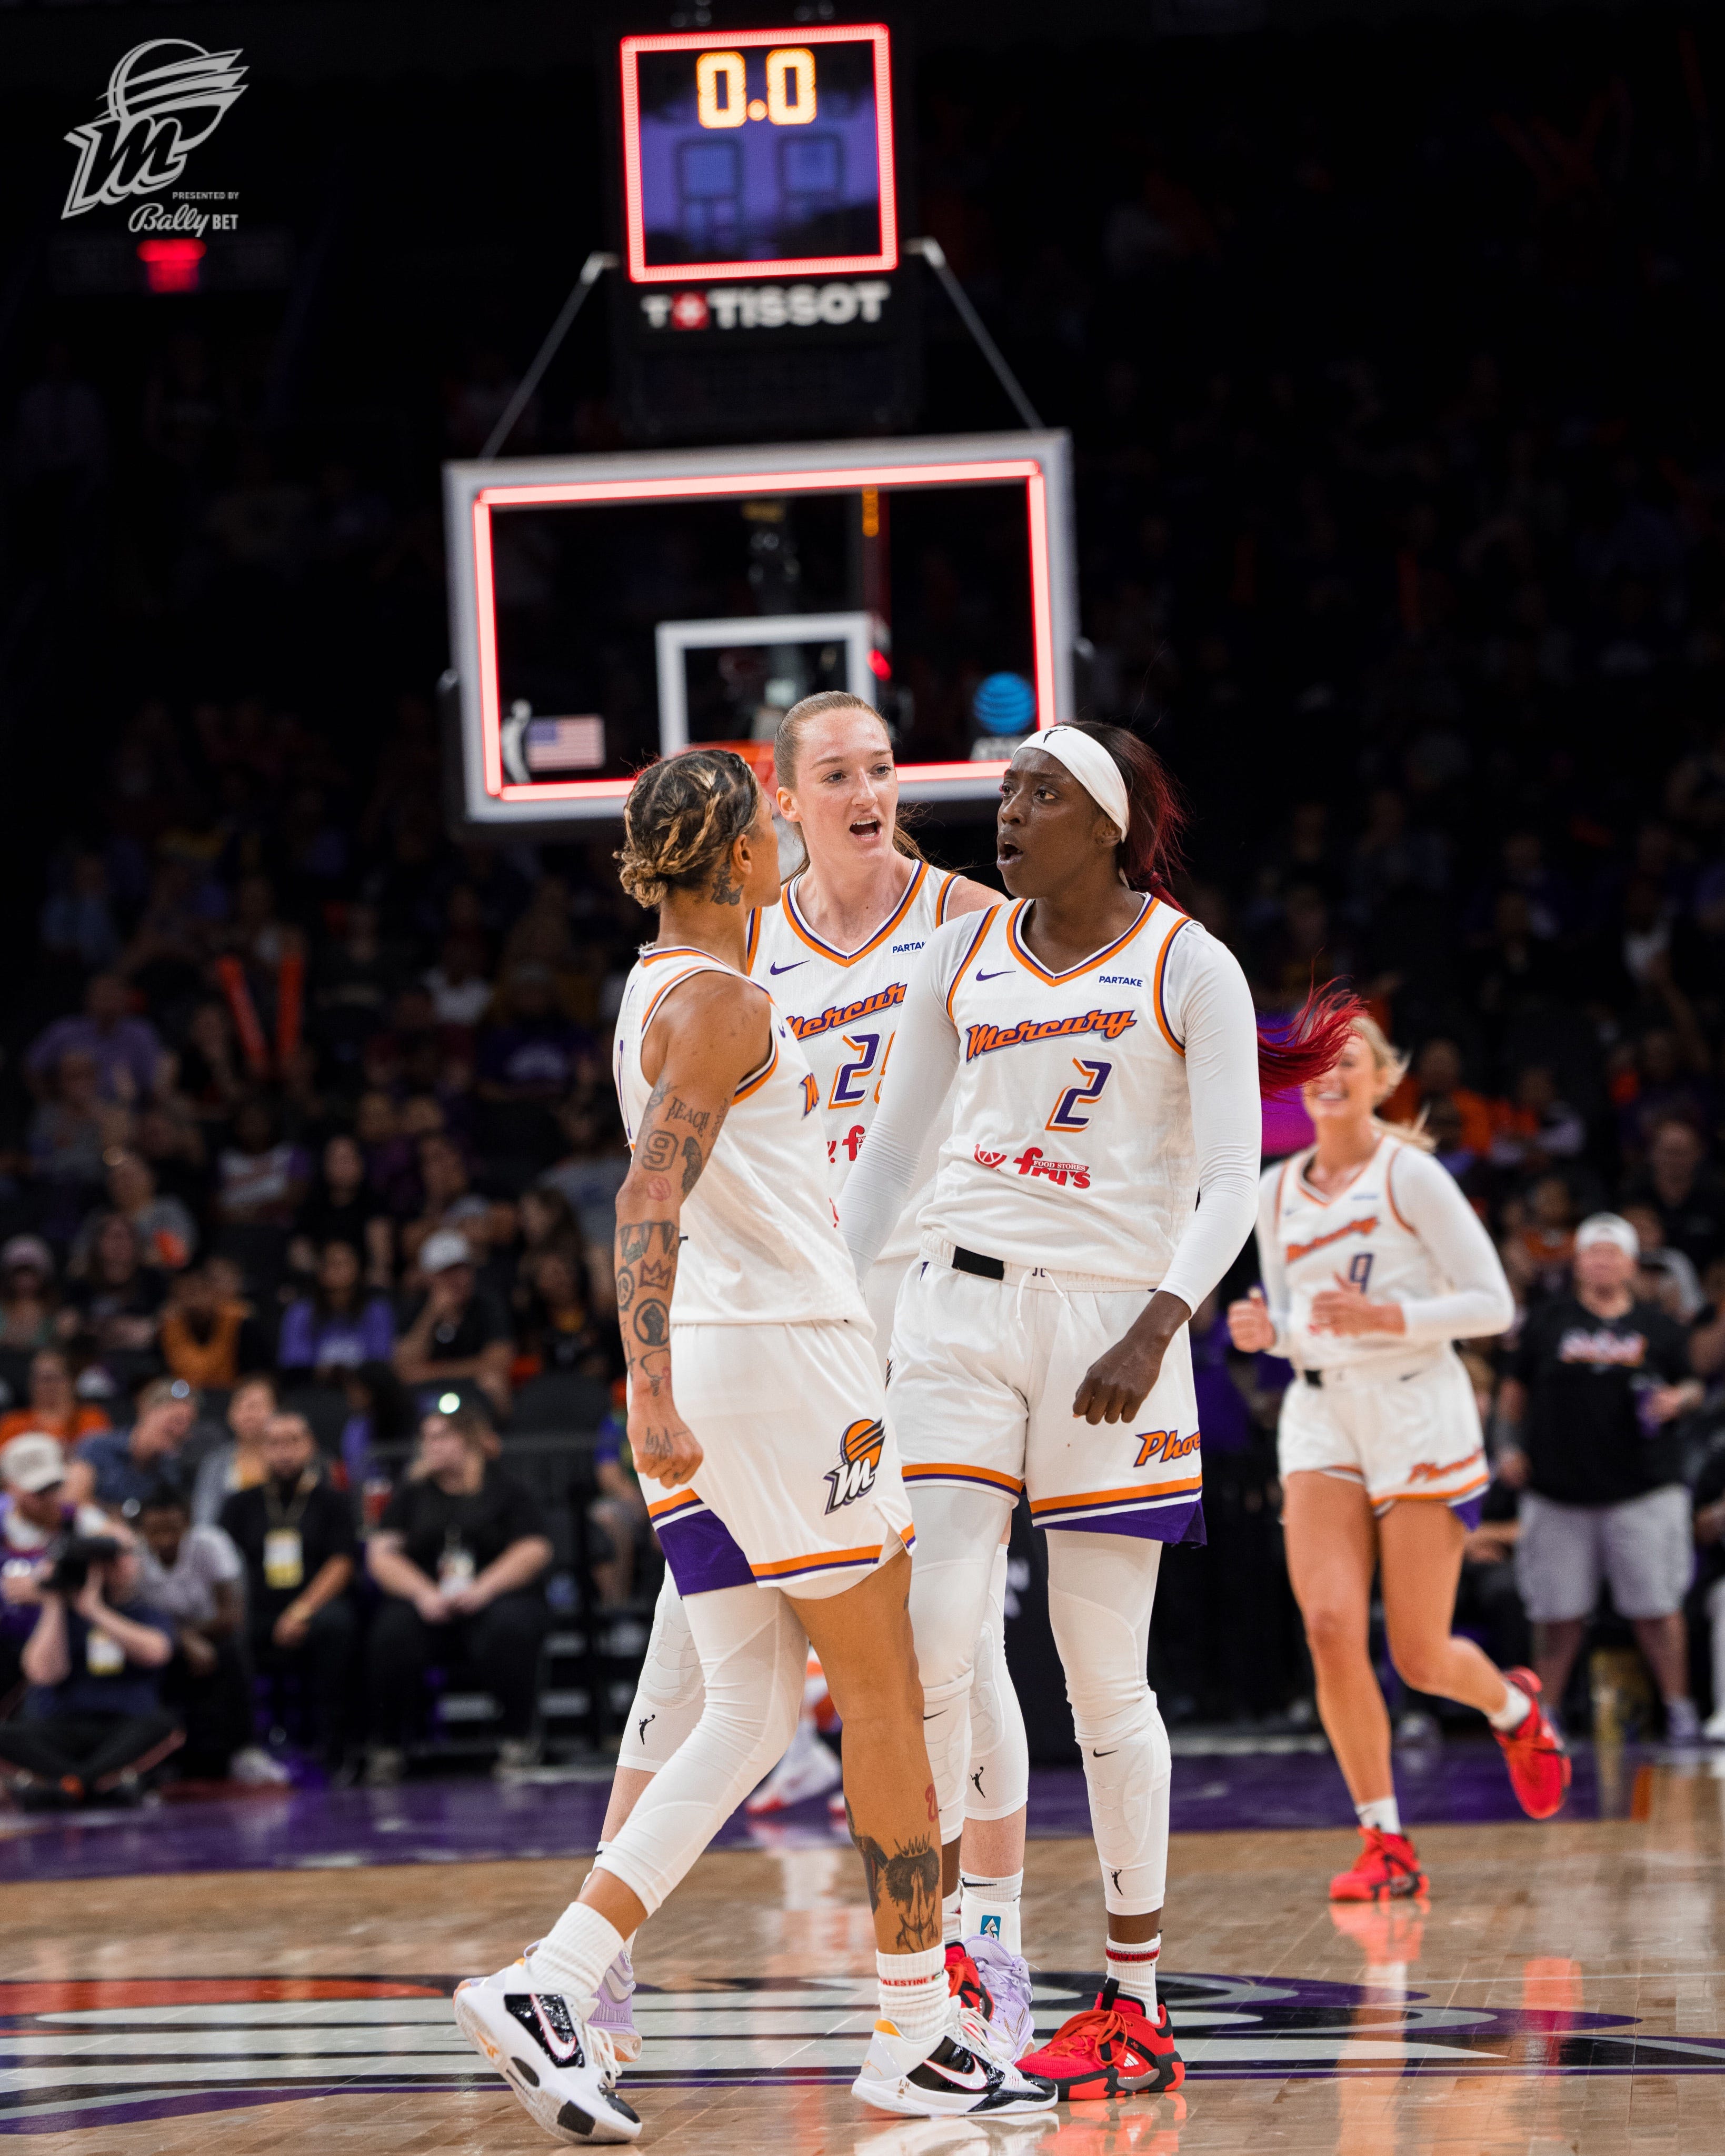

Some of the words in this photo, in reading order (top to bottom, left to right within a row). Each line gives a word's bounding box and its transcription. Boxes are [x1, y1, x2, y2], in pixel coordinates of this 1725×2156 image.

[696, 48, 817, 129] 0.0
[706, 280, 891, 330] TISSOT
[1099, 975, 1143, 987] PARTAKE
[965, 1009, 1138, 1065] Mercury
[828, 1030, 896, 1110] 2
[1045, 1056, 1116, 1133] 2
[1013, 1147, 1091, 1189] fru's
[1033, 1160, 1055, 1169] FOOD
[1057, 1163, 1086, 1172] STORES
